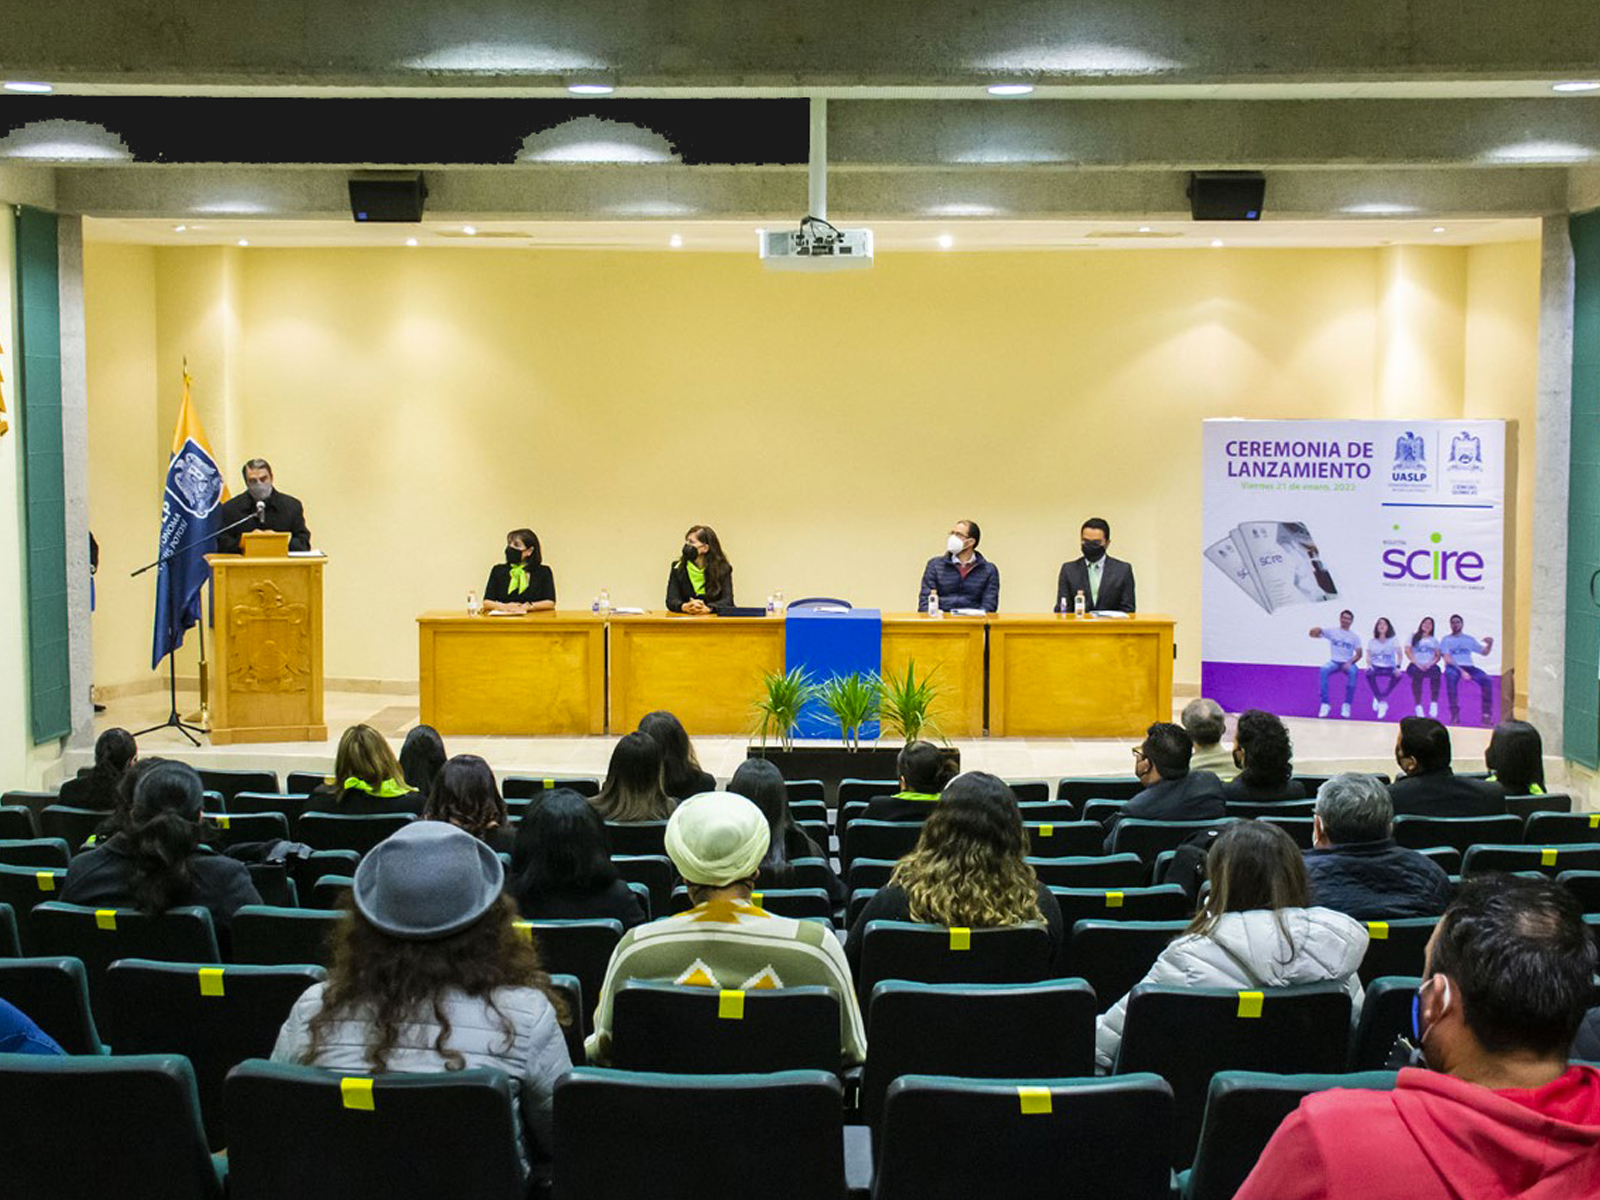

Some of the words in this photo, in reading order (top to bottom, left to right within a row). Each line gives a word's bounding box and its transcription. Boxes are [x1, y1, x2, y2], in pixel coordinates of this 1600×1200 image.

[1225, 440, 1341, 458] CEREMONIA
[1347, 441, 1374, 459] DE
[1227, 460, 1372, 479] LANZAMIENTO
[1392, 472, 1427, 482] UASLP
[1240, 481, 1273, 490] Viernes
[1275, 482, 1287, 491] 21
[1289, 481, 1300, 491] de
[1382, 532, 1484, 582] scire
